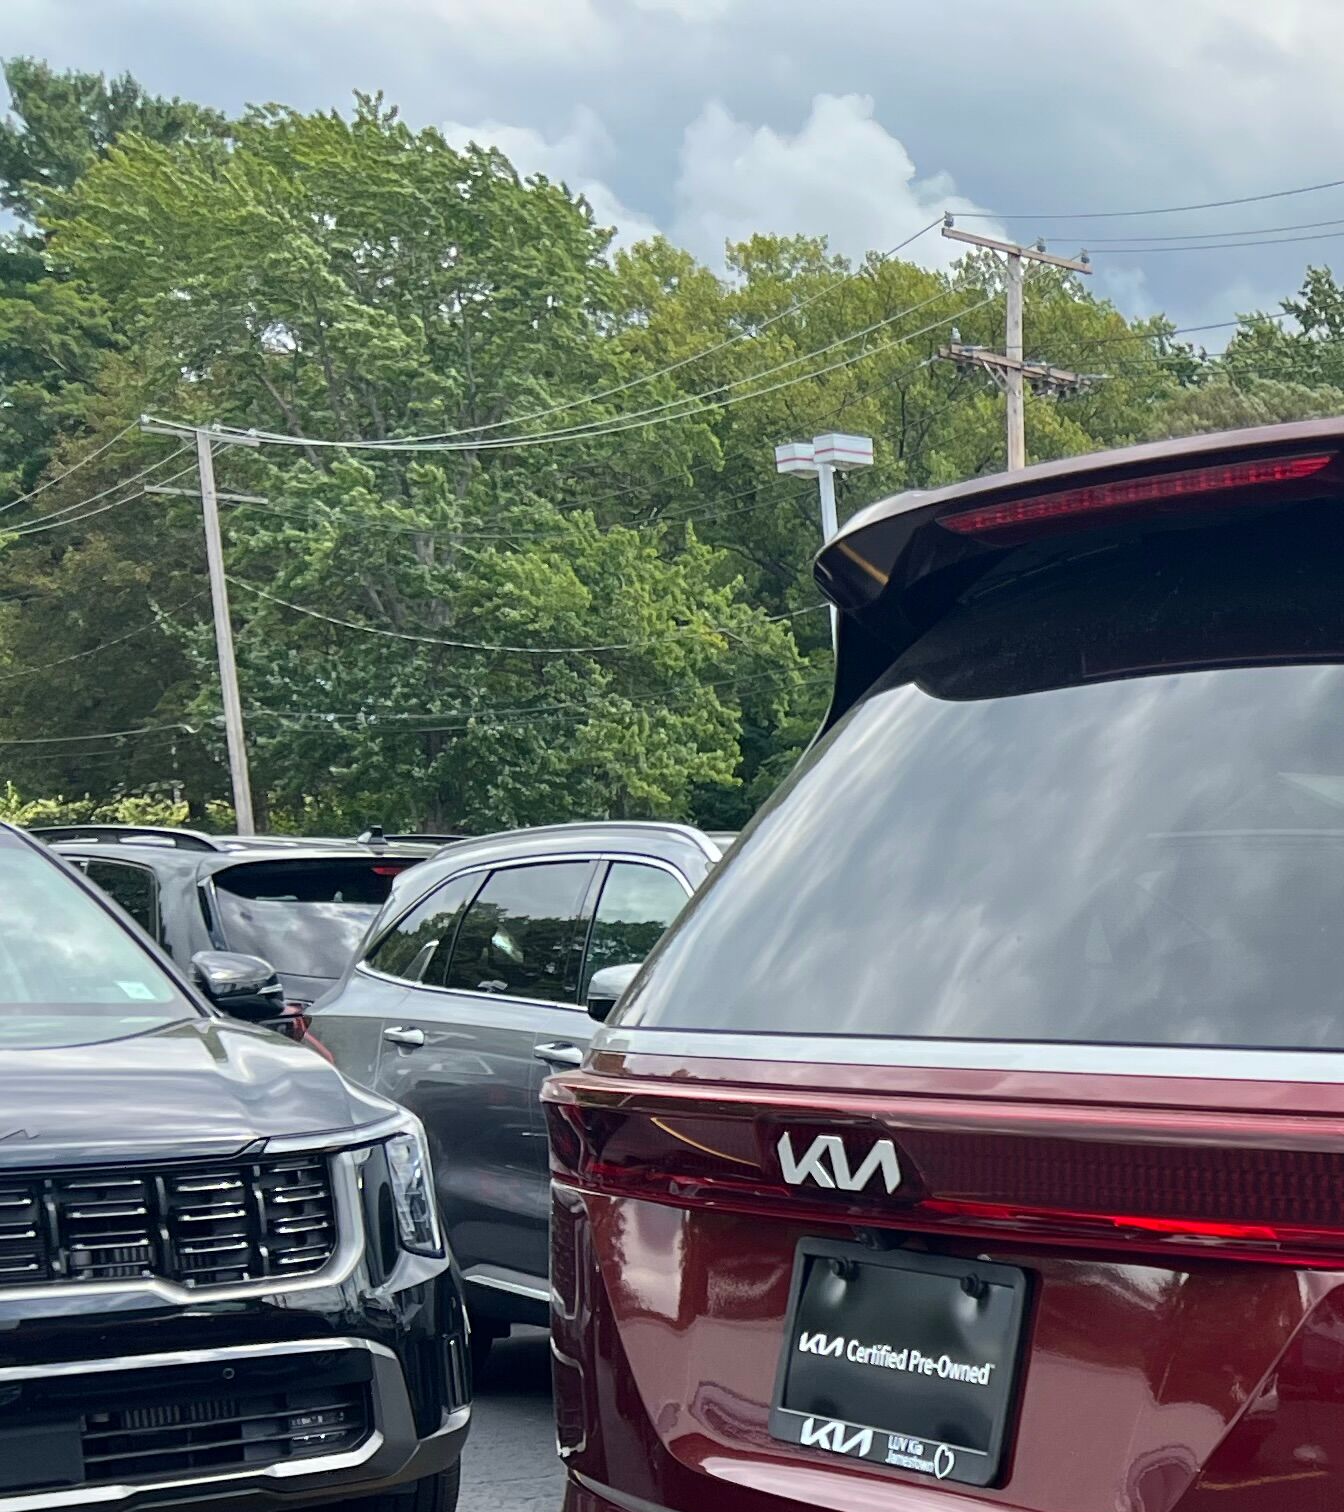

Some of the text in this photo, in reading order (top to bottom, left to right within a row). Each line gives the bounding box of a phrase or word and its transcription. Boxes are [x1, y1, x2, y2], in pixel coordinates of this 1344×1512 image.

[777, 1131, 901, 1194] KIA
[799, 1332, 992, 1386] KIA Certified Pre-Owned
[800, 1417, 873, 1457] KIA
